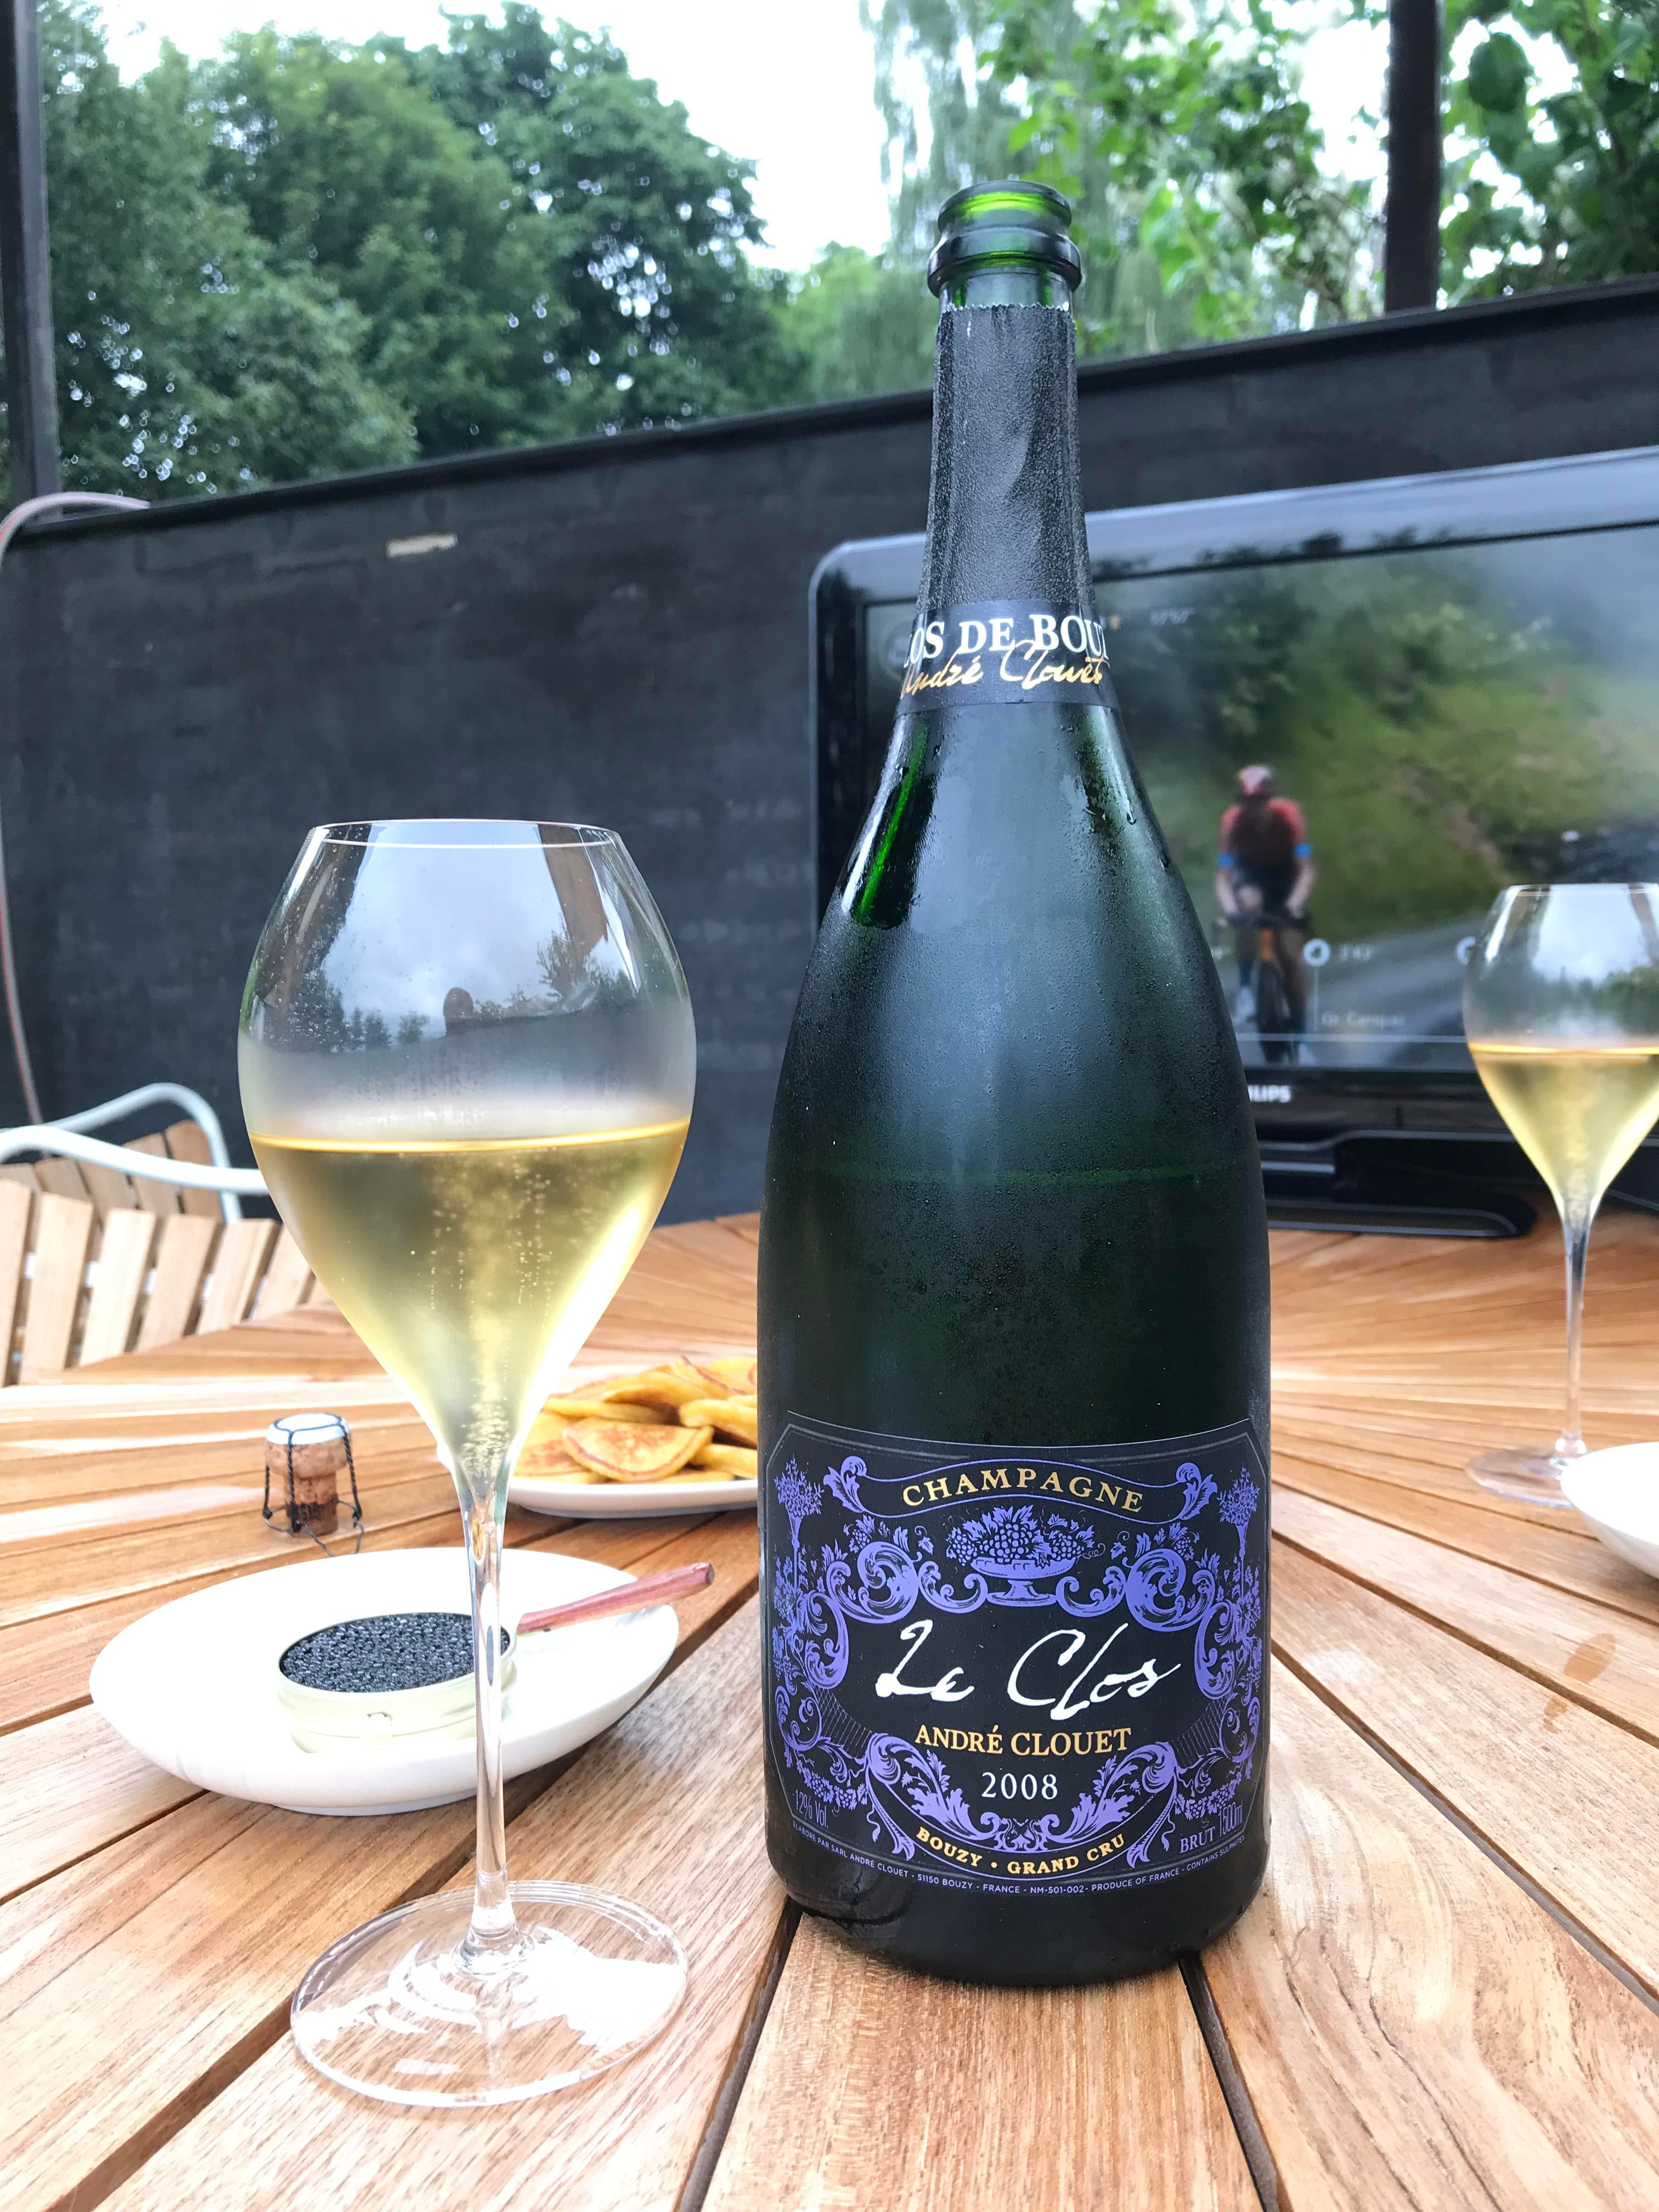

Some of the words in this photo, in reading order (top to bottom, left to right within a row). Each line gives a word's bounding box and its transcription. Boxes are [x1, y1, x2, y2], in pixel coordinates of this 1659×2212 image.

[904, 621, 945, 668] OS
[957, 618, 1015, 654] DE
[902, 1468, 1143, 1514] CHAMPAGNE
[875, 1619, 975, 1702] Le
[1007, 1622, 1181, 1721] Clos
[915, 1724, 1003, 1755] ANDRÉ
[1011, 1727, 1132, 1756] CLOUET
[795, 1789, 813, 1820] 12%
[815, 1801, 828, 1829] Vol.
[981, 1771, 1058, 1801] 2008
[1180, 1826, 1216, 1854] BRUT
[1218, 1797, 1243, 1838] 1500ml
[817, 1837, 830, 1849] PAR
[831, 1844, 848, 1858] SARL
[850, 1853, 875, 1869] ANDRÉ
[877, 1863, 909, 1878] CLOUET
[917, 1874, 939, 1884] 51150
[942, 1878, 974, 1889] BOUZY
[983, 1883, 1020, 1894] FRANCE
[1092, 1879, 1132, 1892] PRODUCE
[1135, 1876, 1146, 1884] OF
[1149, 1867, 1180, 1882] FRANCE
[1186, 1852, 1219, 1871] CONTAINS
[1220, 1833, 1245, 1857] SULPHITES
[916, 1826, 983, 1867] BOUZY
[1007, 1855, 1080, 1875] GRAND
[1086, 1834, 1126, 1862] CRU
